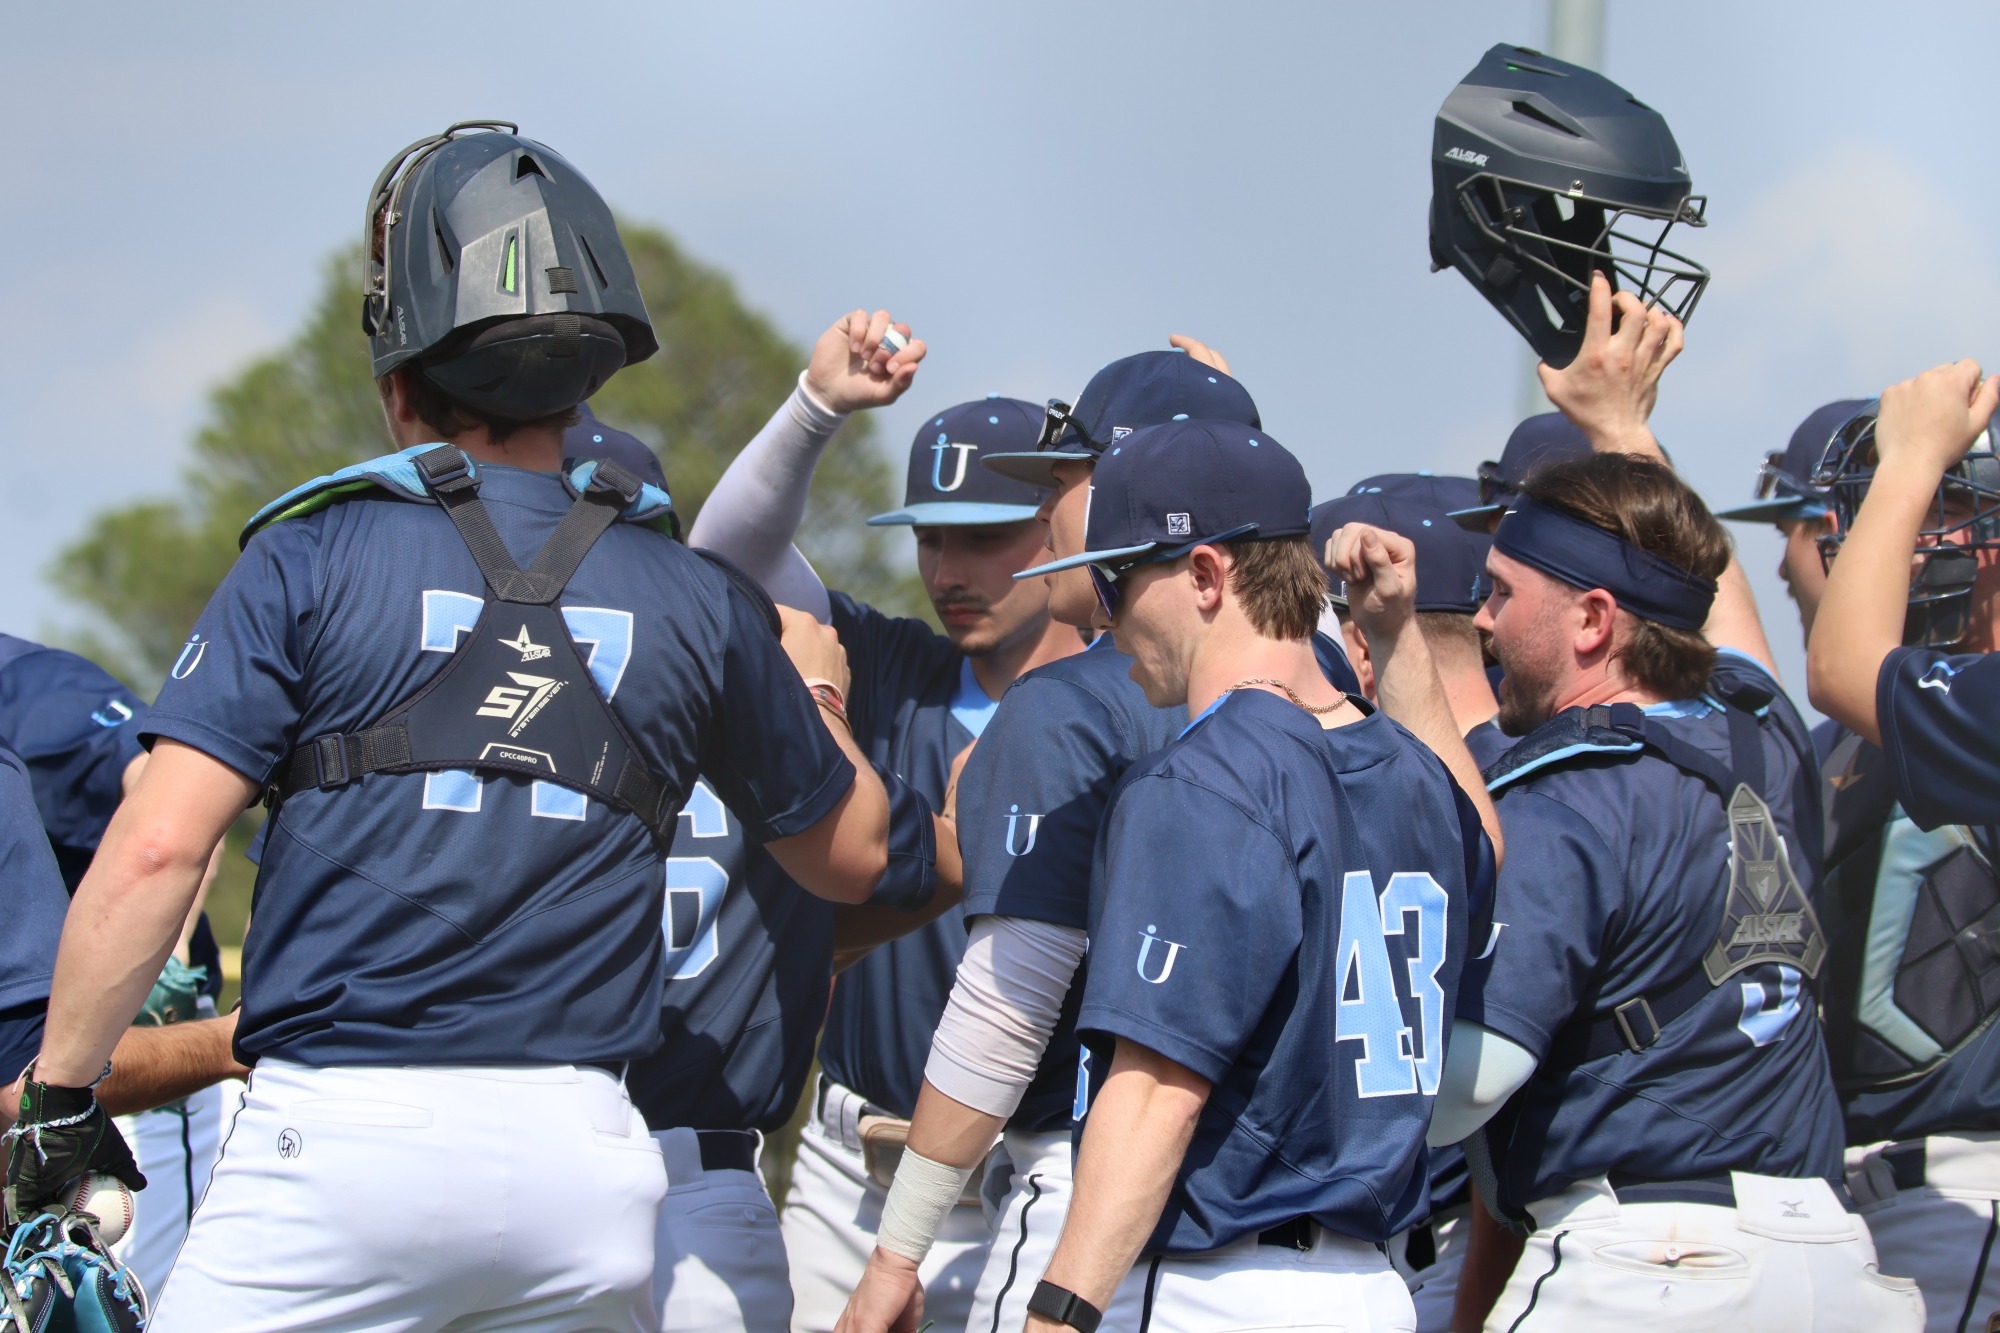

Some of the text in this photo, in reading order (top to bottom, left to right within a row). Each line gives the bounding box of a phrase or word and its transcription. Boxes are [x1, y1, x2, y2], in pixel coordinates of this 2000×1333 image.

[520, 648, 552, 662] ALL-STAR
[499, 751, 538, 765] CPCC40PRO
[1733, 914, 1805, 944] ALL-STAR
[1335, 869, 1449, 1099] 43
